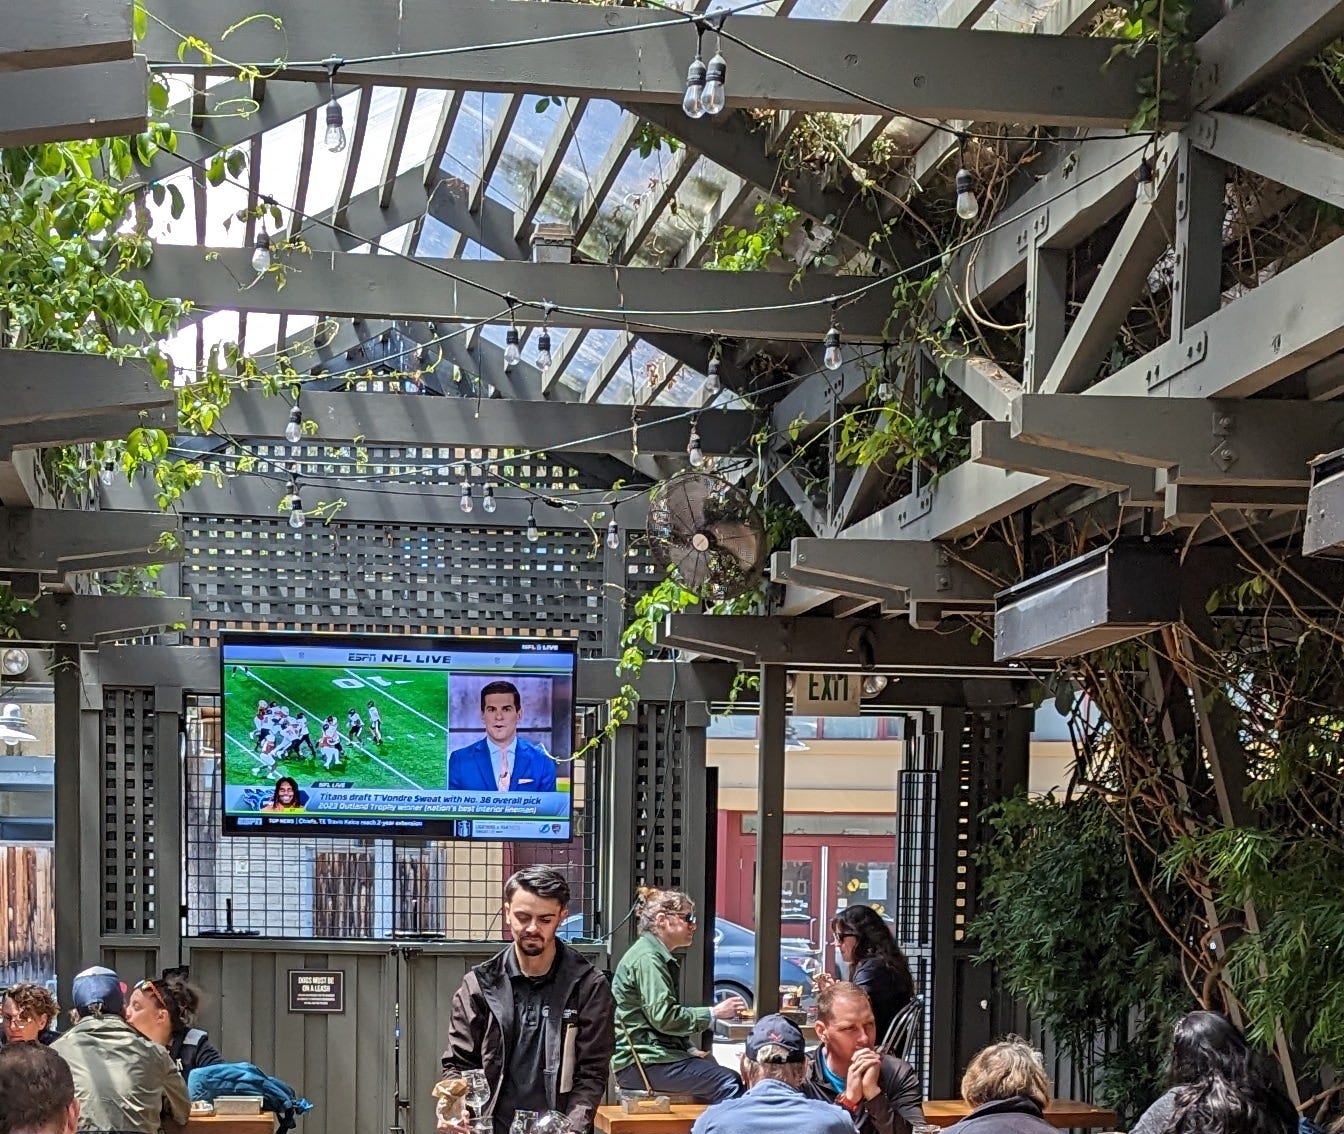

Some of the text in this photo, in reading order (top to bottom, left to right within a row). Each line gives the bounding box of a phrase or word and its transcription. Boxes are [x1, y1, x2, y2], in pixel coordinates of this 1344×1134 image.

[348, 653, 452, 664] ESPN NFL LIVE
[809, 673, 849, 702] EXIT
[320, 792, 348, 801] Titans
[349, 793, 372, 802] draft
[414, 795, 442, 803] Sweat
[492, 796, 522, 805] overall
[522, 796, 542, 806] pick
[370, 803, 396, 812] Trophy
[476, 805, 504, 813] interior
